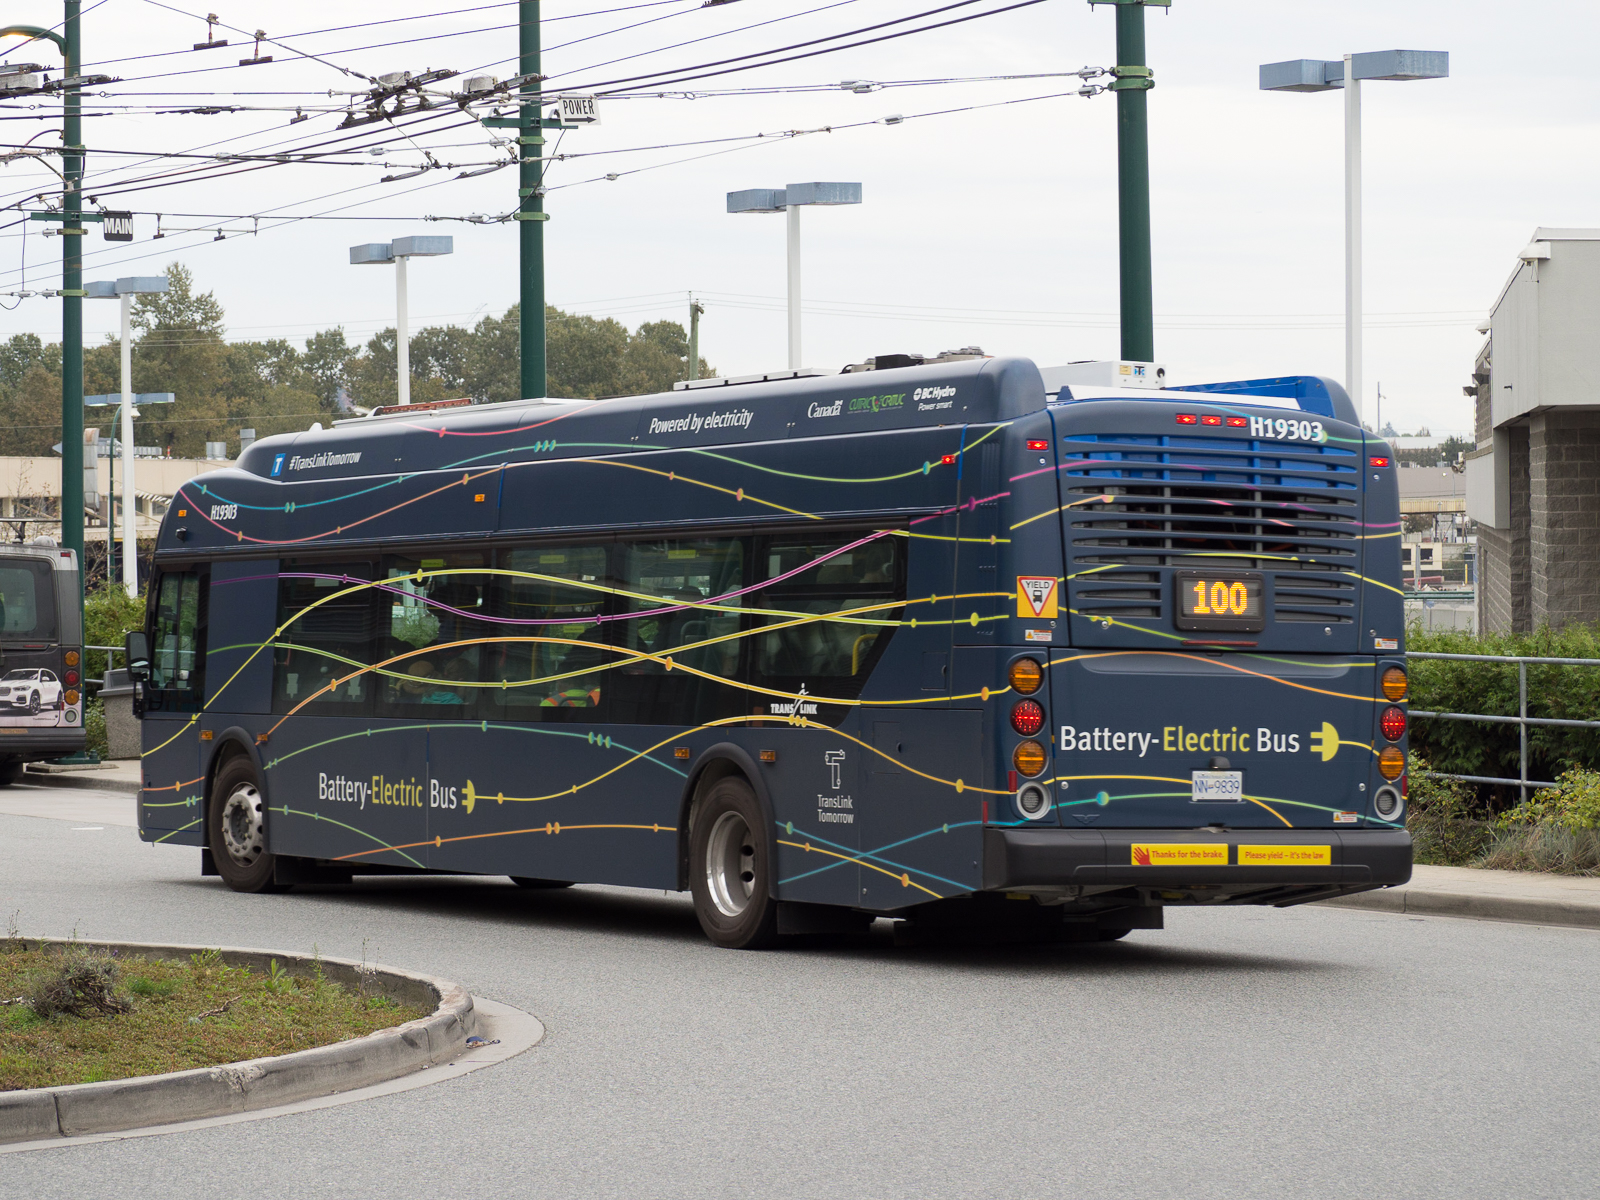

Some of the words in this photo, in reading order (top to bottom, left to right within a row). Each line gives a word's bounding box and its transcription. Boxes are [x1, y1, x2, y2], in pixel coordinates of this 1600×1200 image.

[563, 99, 595, 115] POWER
[104, 217, 132, 235] MAIN
[808, 402, 841, 418] Canada
[649, 414, 691, 434] Powered
[690, 413, 704, 433] by
[704, 408, 754, 430] electricity
[1250, 416, 1324, 442] H19303
[289, 452, 362, 471] #TransLinkTomorrow
[211, 504, 238, 520] H19303
[1025, 581, 1050, 589] YIELD
[1193, 580, 1248, 615] 100
[770, 703, 794, 714] TRANS
[800, 704, 818, 714] LINK
[1060, 725, 1250, 757] Battery-Electric
[1256, 727, 1300, 753] Bus
[319, 772, 423, 810] Battery-Electric
[430, 779, 457, 810] Bus
[817, 794, 853, 809] TransLink
[817, 809, 855, 824] Tomorrow
[1152, 850, 1176, 858] Thanks
[1178, 850, 1188, 858] for
[1190, 850, 1201, 858] the
[1203, 850, 1224, 858] brake.
[1245, 851, 1266, 859] Please
[1267, 851, 1283, 860] yield
[1301, 851, 1312, 859] the
[1313, 851, 1324, 859] law
